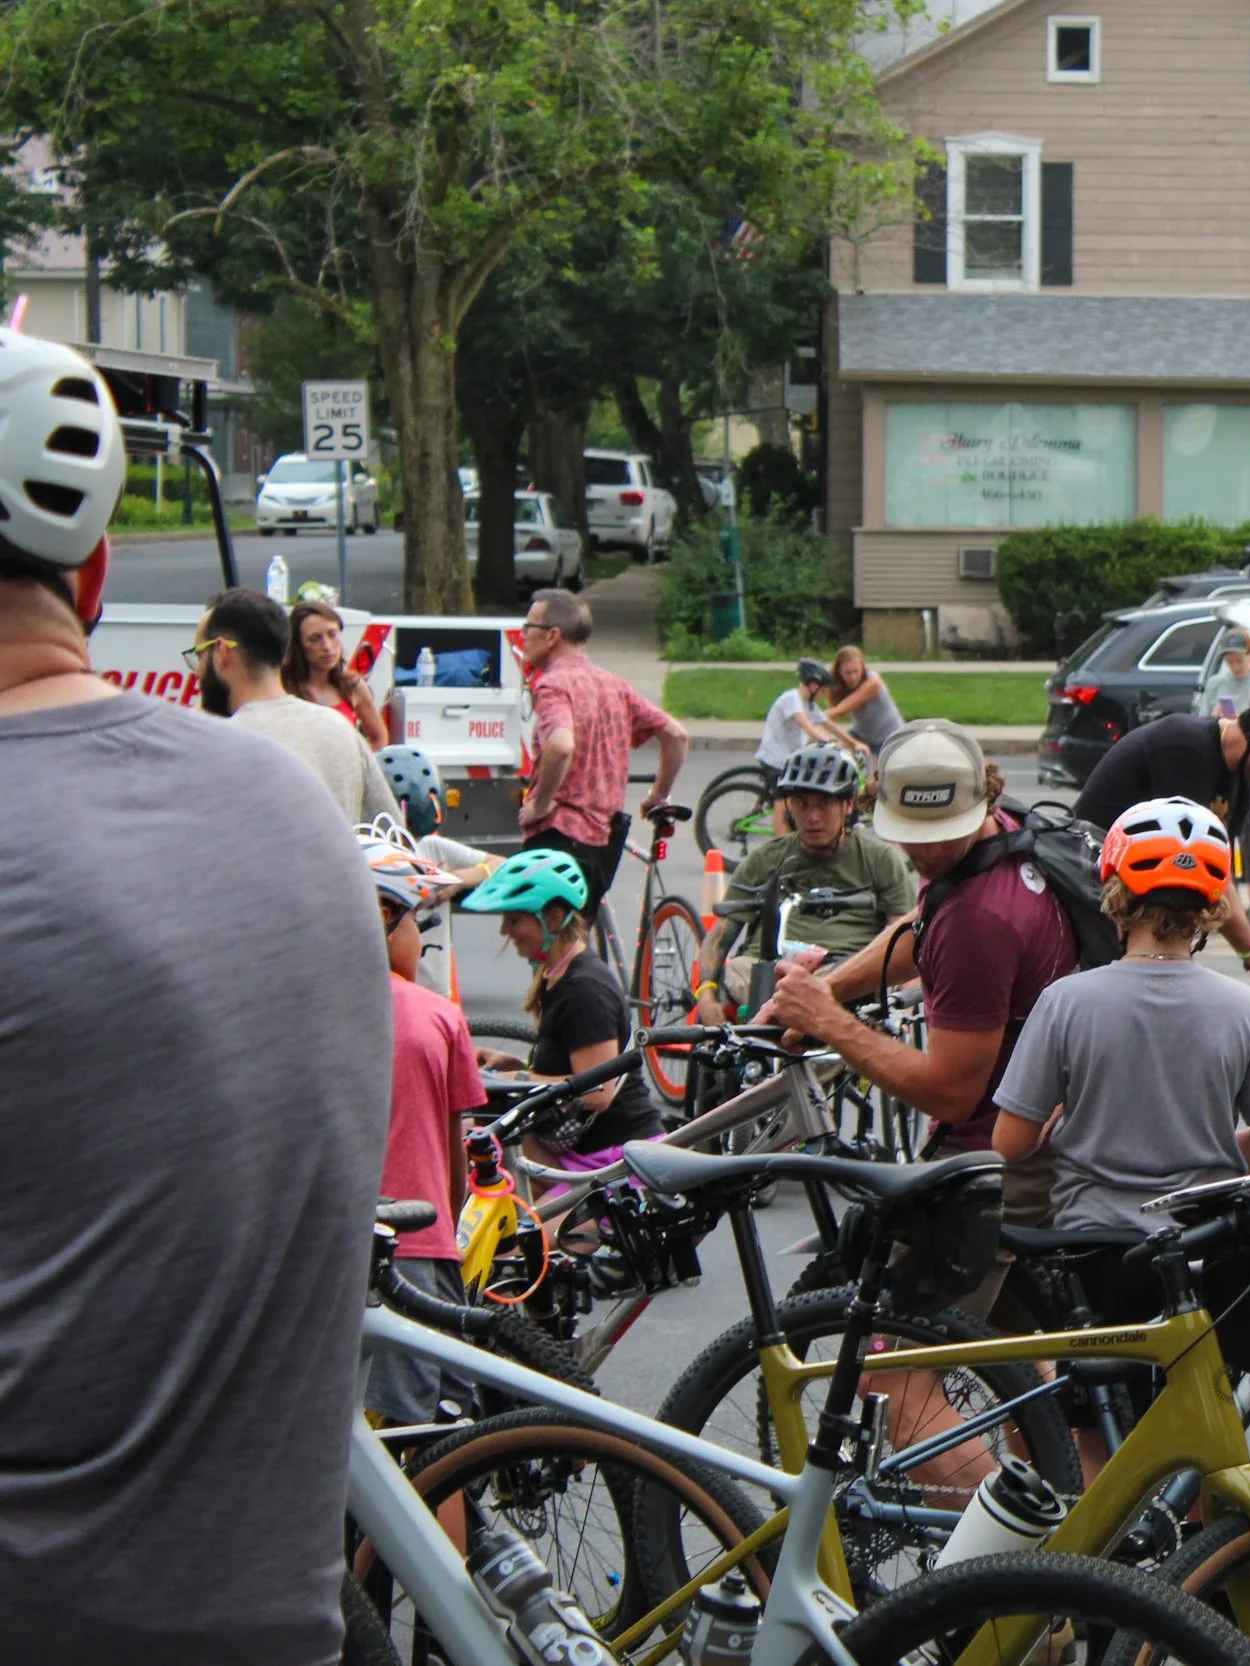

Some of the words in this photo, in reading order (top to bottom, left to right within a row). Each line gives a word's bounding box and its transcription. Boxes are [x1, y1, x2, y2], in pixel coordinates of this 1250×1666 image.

[310, 391, 362, 404] SPEED
[316, 407, 356, 420] LIMIT
[313, 424, 363, 452] 25
[468, 721, 505, 738] POLICE
[1069, 1331, 1147, 1348] cannondale
